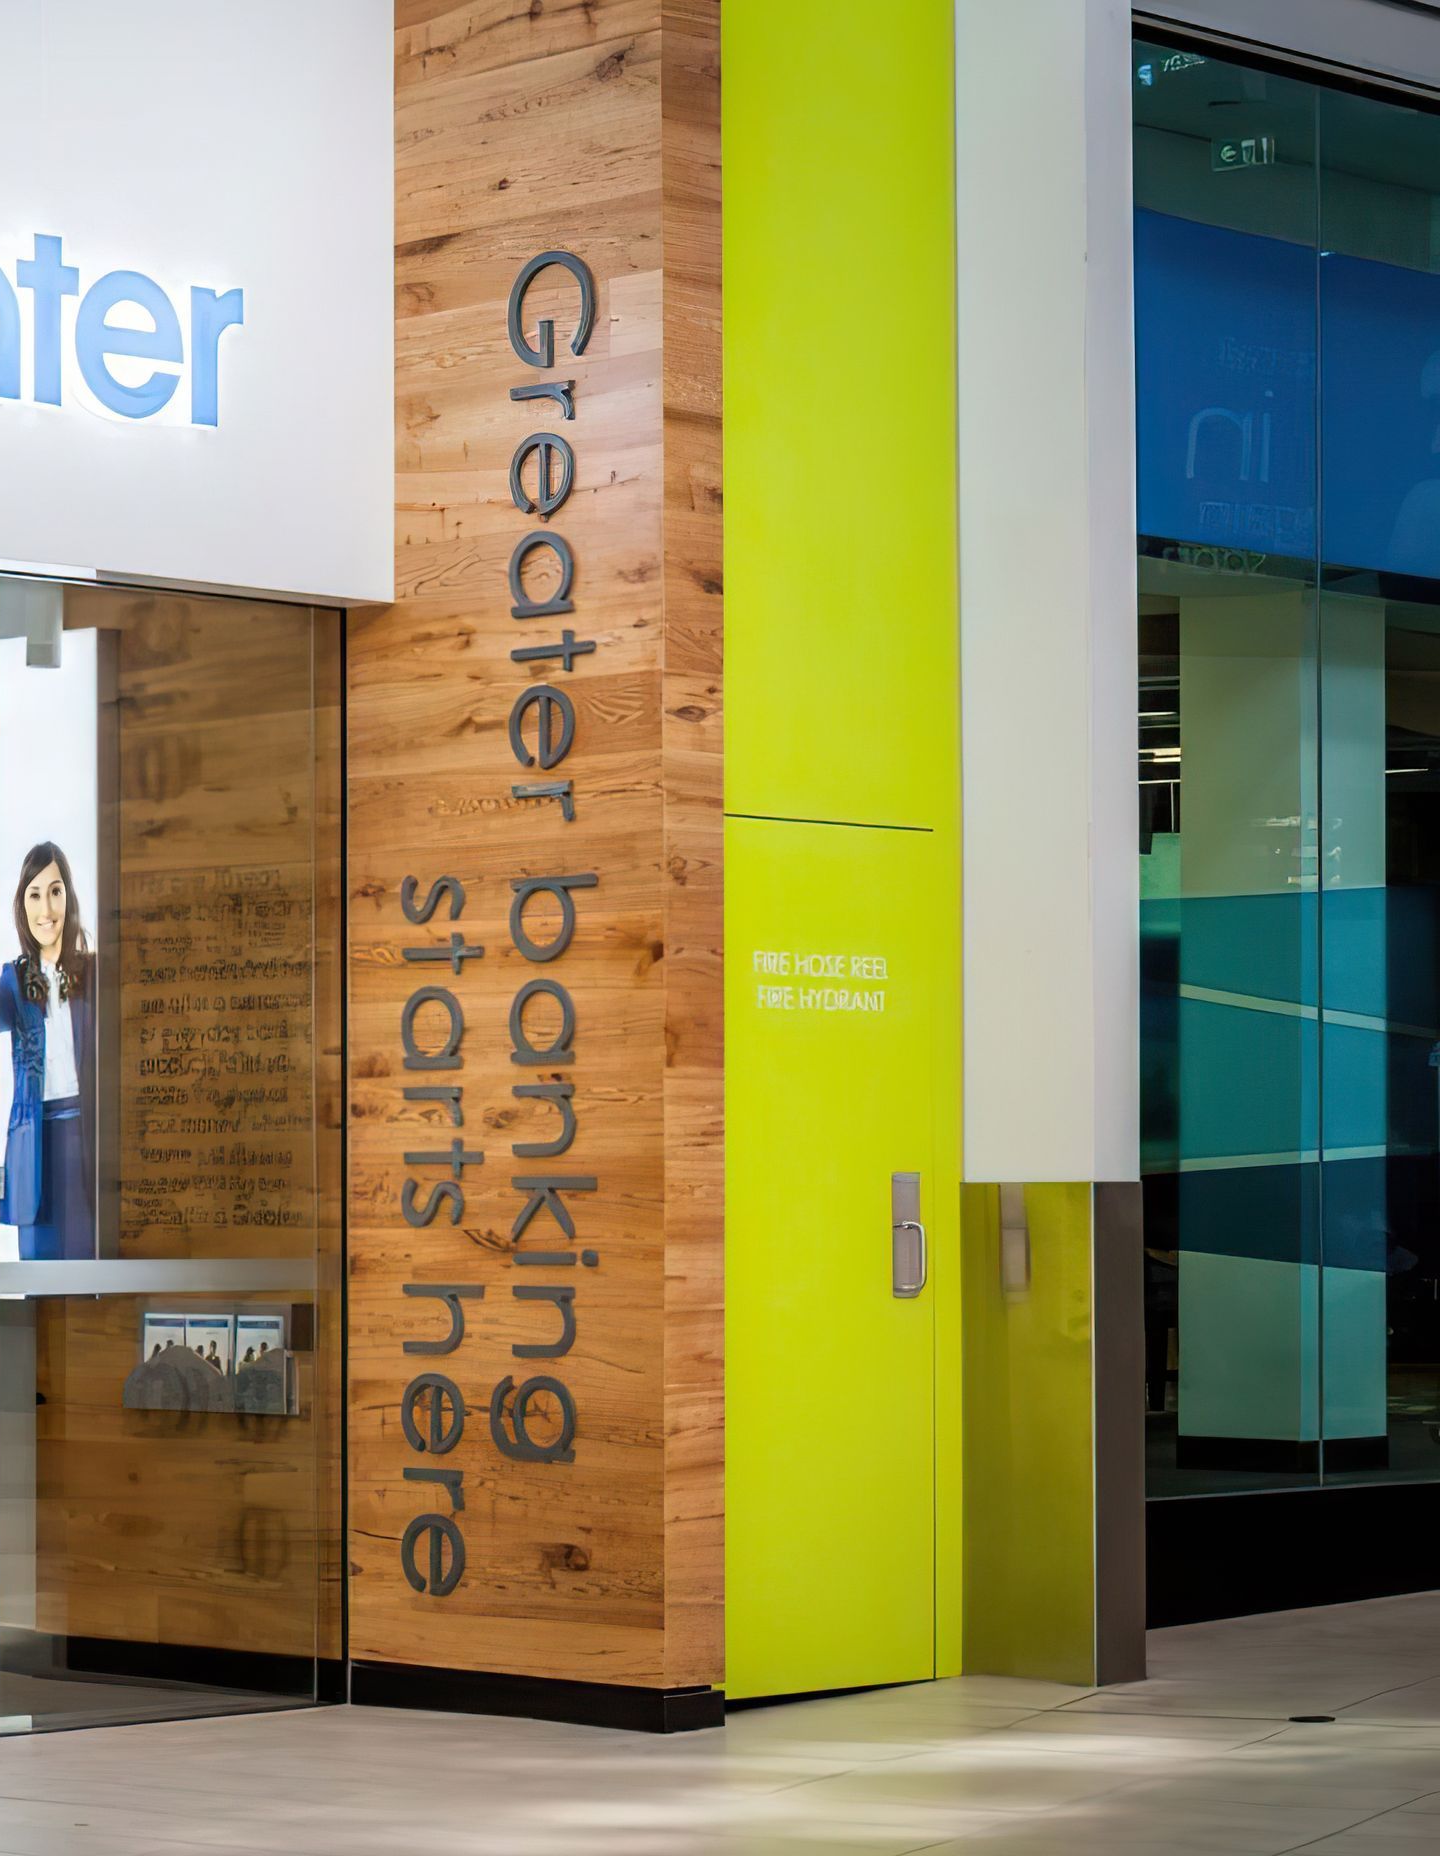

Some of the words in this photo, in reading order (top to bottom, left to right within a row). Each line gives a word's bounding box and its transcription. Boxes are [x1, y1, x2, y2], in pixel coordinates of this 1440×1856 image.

[508, 250, 598, 823] Greater
[401, 873, 485, 1228] starts
[753, 951, 791, 976] FIRE
[794, 953, 846, 979] HOSE
[757, 985, 794, 1011] FIRE
[799, 989, 886, 1013] HYDRANT
[490, 873, 599, 1463] banking
[401, 1284, 485, 1597] here
